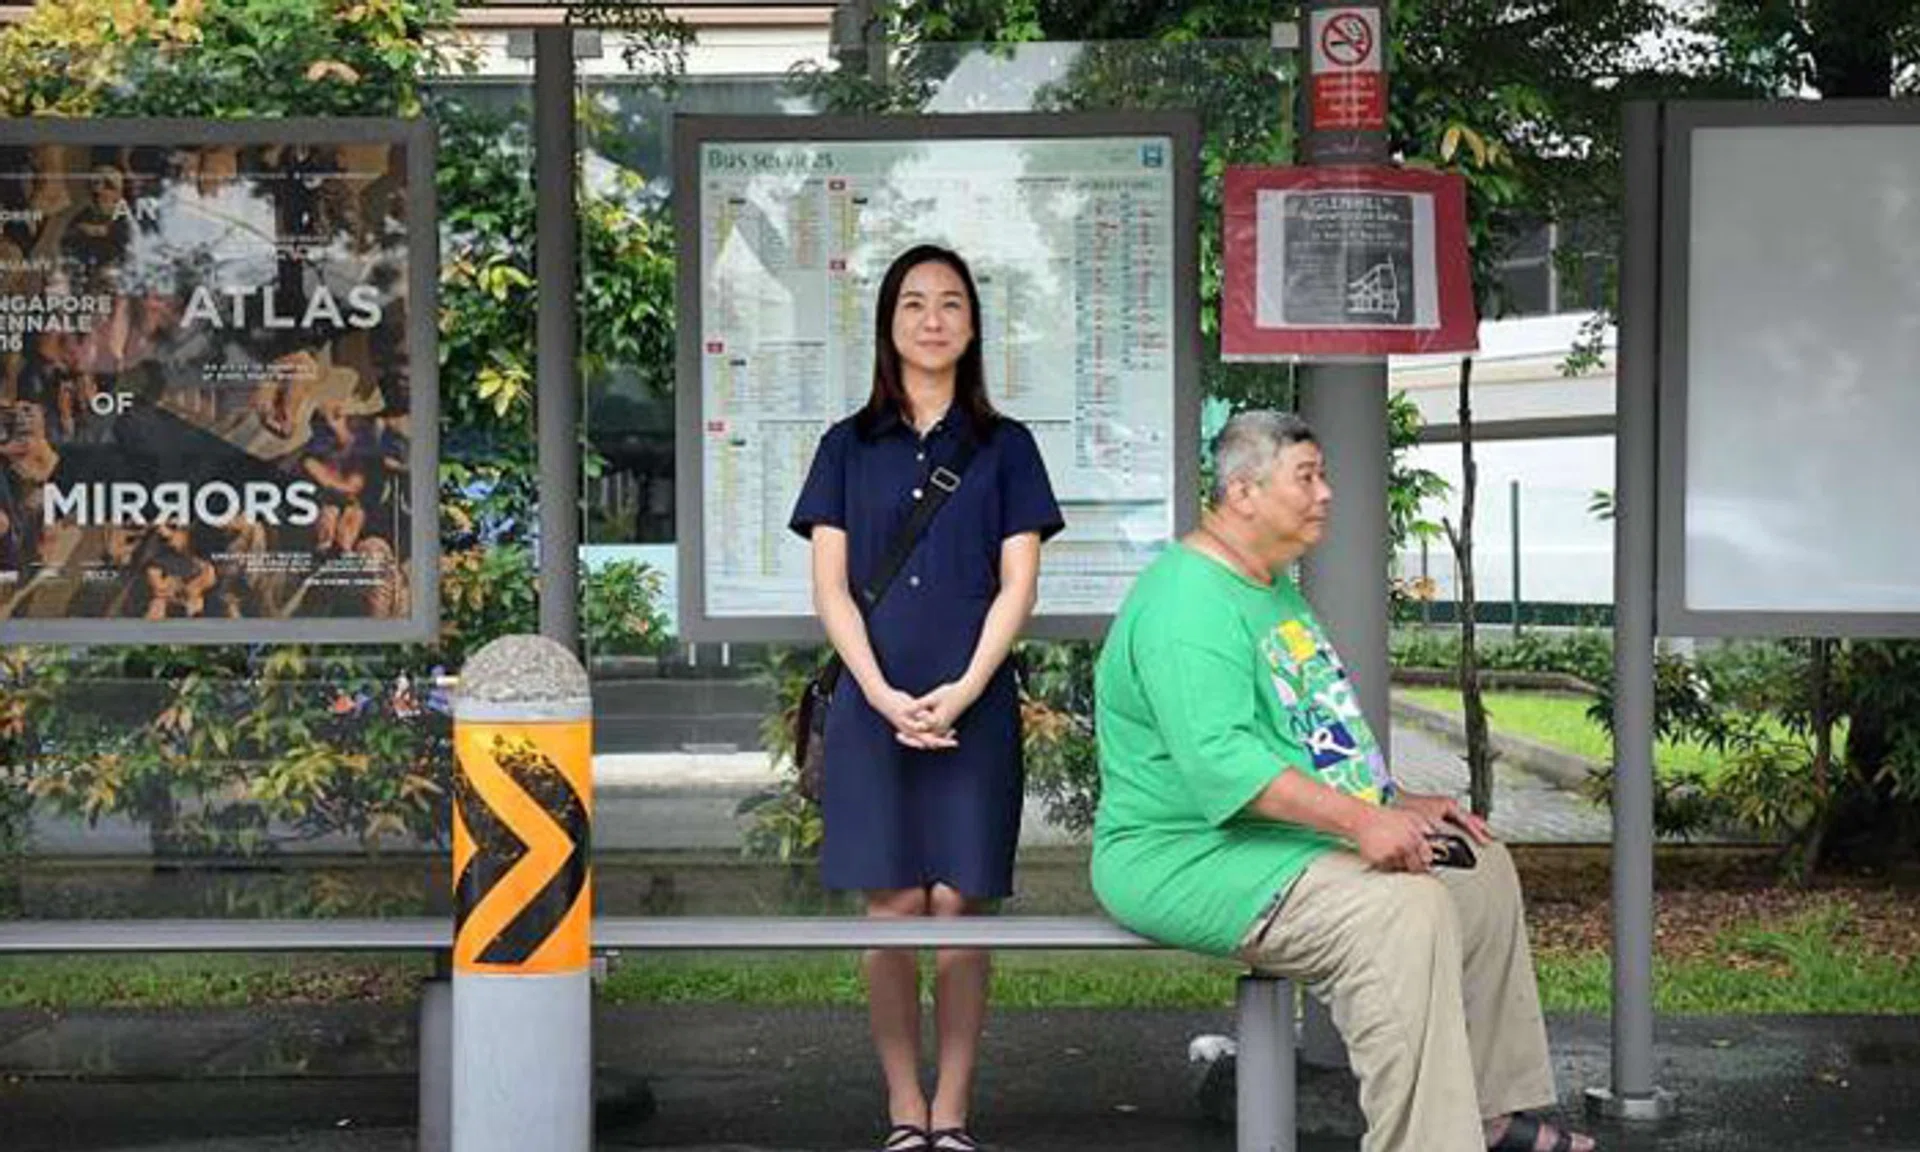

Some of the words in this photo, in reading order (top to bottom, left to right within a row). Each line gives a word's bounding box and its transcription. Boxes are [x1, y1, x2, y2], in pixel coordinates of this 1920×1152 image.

[708, 149, 747, 169] Bus
[113, 198, 158, 221] AN
[181, 284, 382, 329] ATLAS
[91, 393, 134, 415] OF
